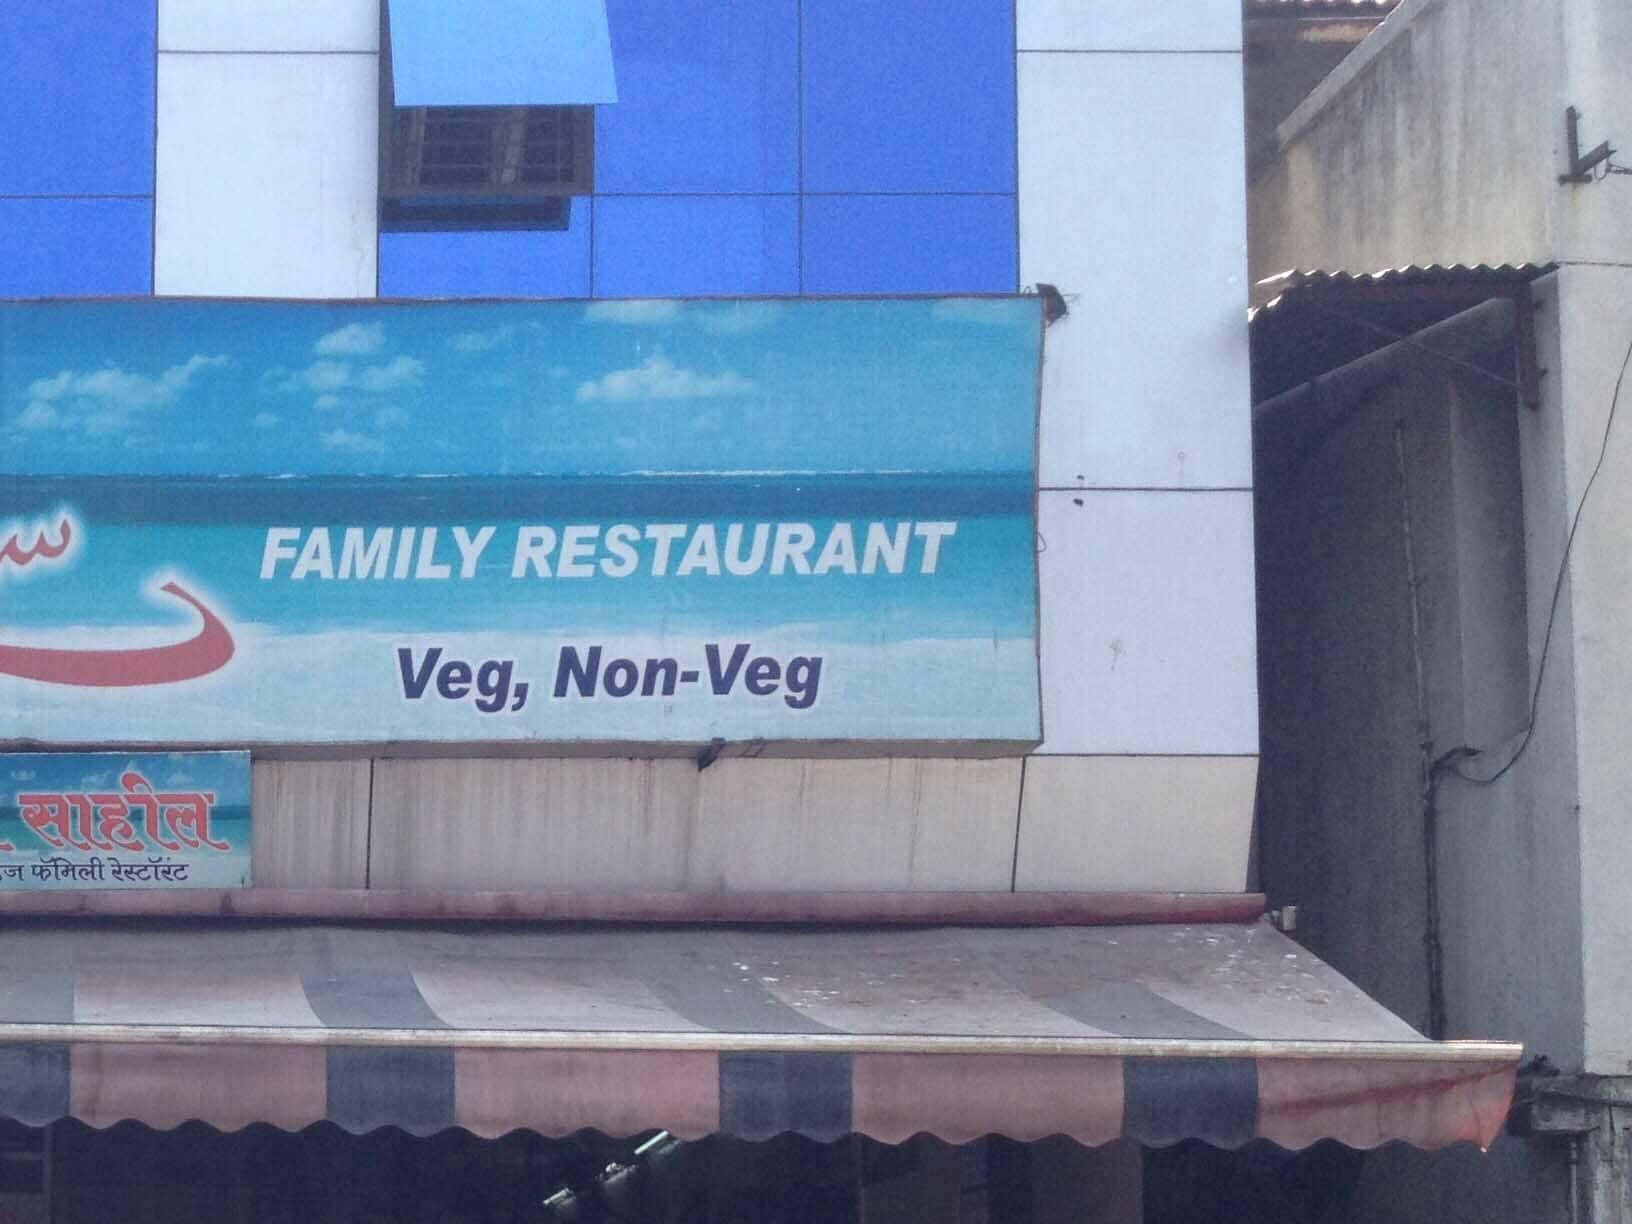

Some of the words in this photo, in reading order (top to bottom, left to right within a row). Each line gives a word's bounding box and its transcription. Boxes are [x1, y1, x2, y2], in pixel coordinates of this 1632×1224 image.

[259, 526, 496, 580] FAMILY
[511, 521, 957, 578] RESTAURANT
[396, 646, 530, 713] Veg,
[553, 643, 824, 710] Non-Veg
[17, 771, 231, 853] साहील
